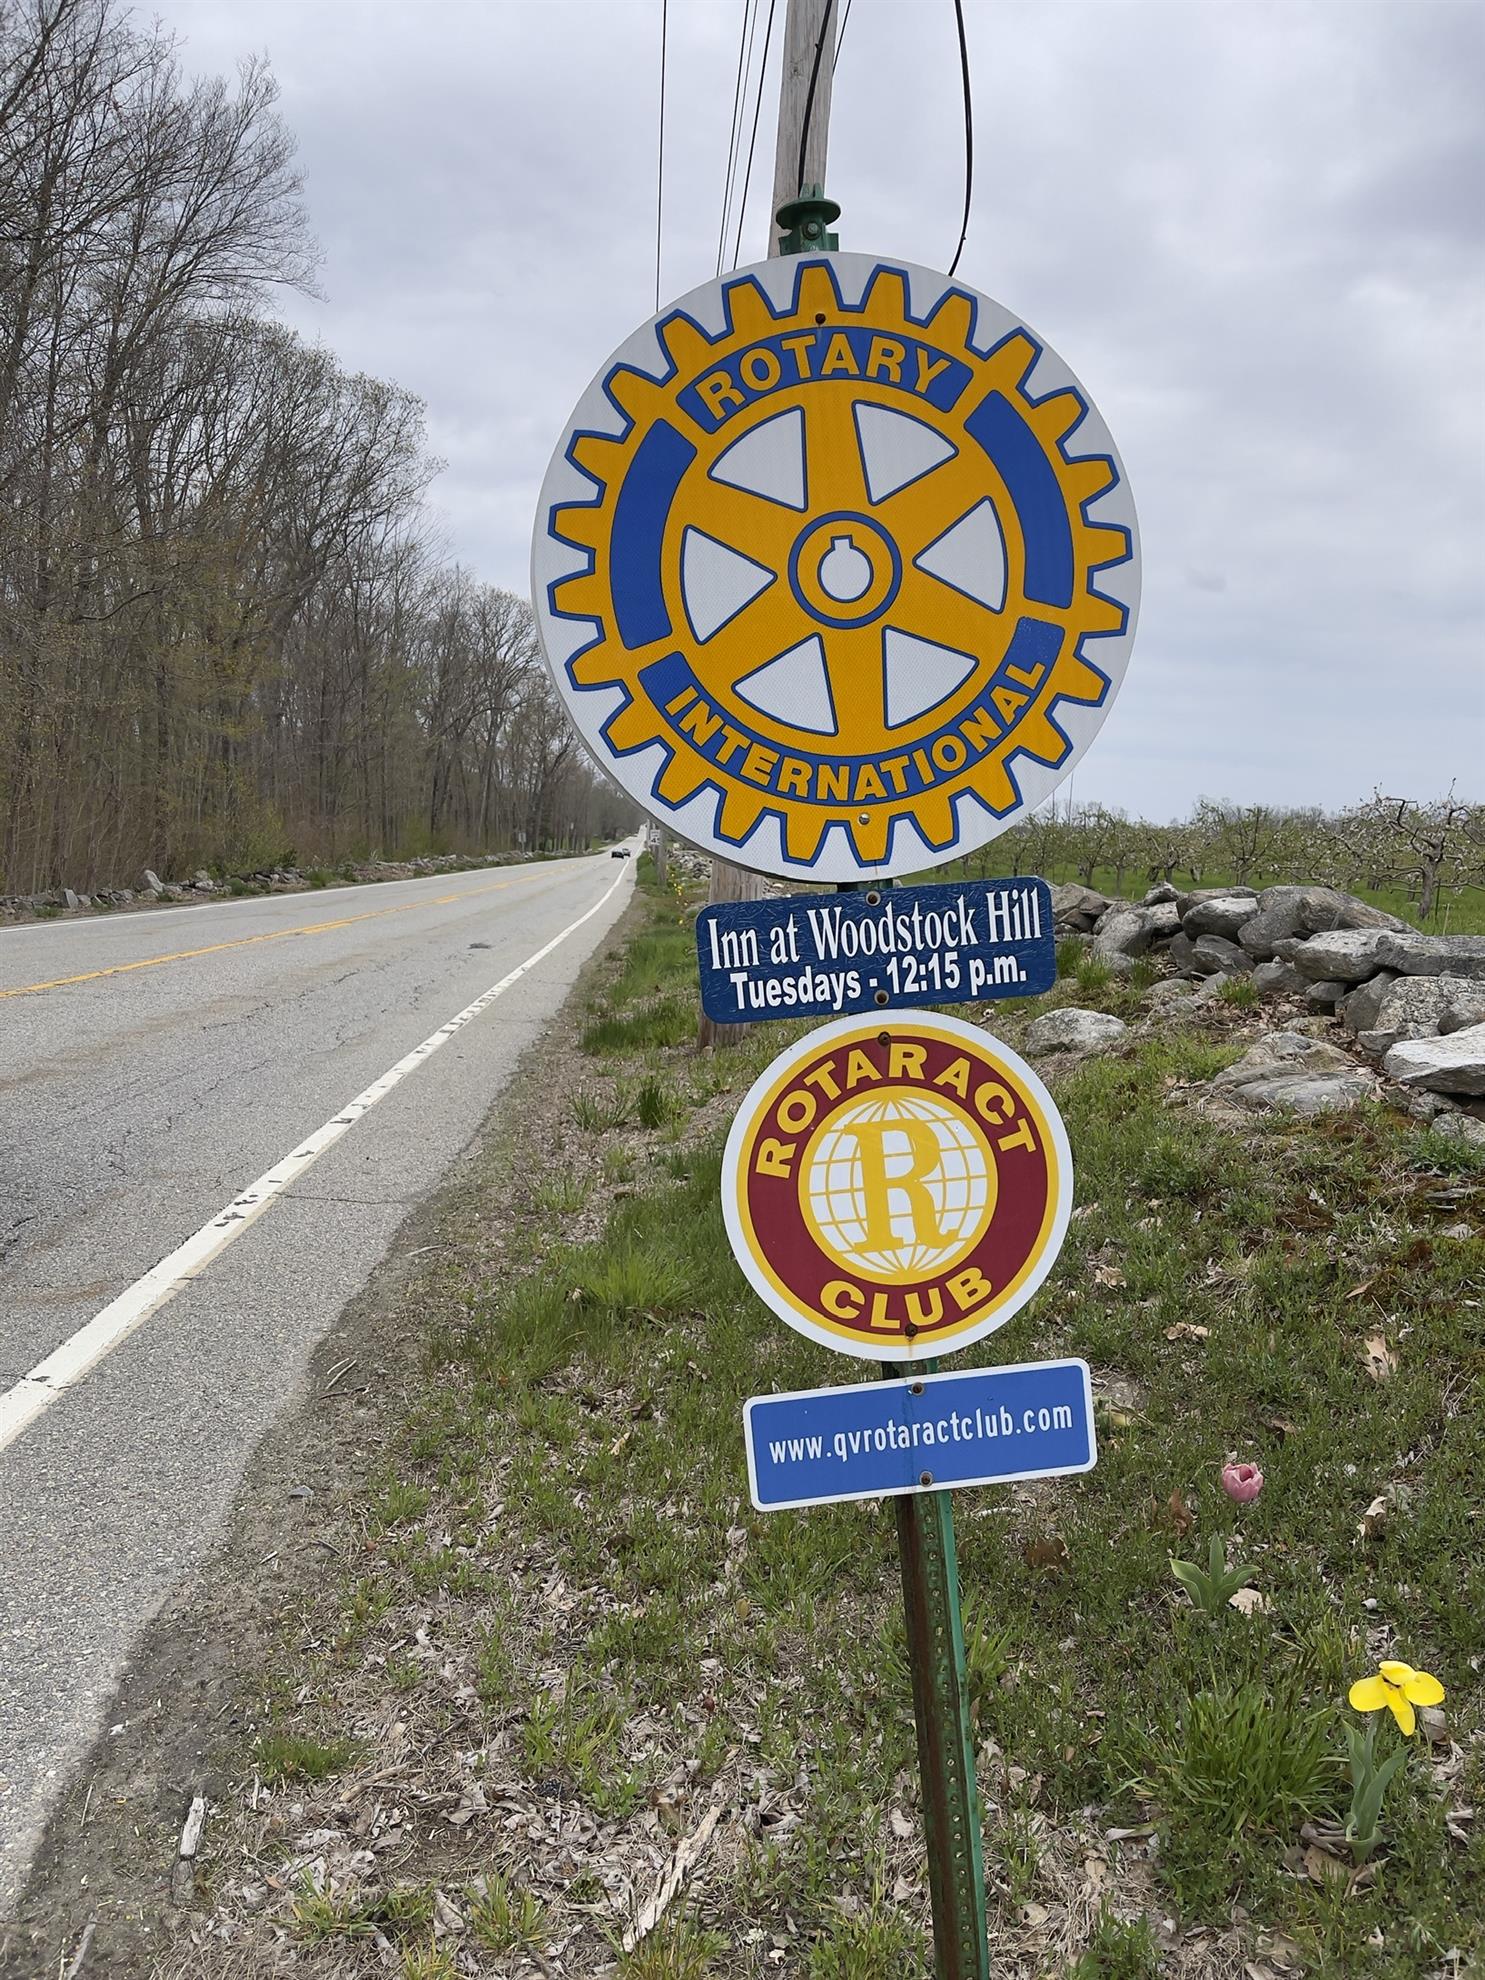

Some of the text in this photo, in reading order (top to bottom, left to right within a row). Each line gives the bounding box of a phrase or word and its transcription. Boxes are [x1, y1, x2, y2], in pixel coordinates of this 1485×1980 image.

[695, 333, 952, 421] ROTARY
[664, 661, 1046, 801] INTERNATIONAL
[708, 887, 1042, 970] Inn at Woodstock Hill
[730, 965, 861, 1011] Tuesdays
[886, 951, 960, 994] 12:15
[968, 953, 1027, 995] p.m.
[756, 1043, 1036, 1179] ROTARACT
[843, 1118, 960, 1254] R
[819, 1267, 993, 1329] CLUB
[769, 1404, 1073, 1463] www.qvrotaractclub.com
